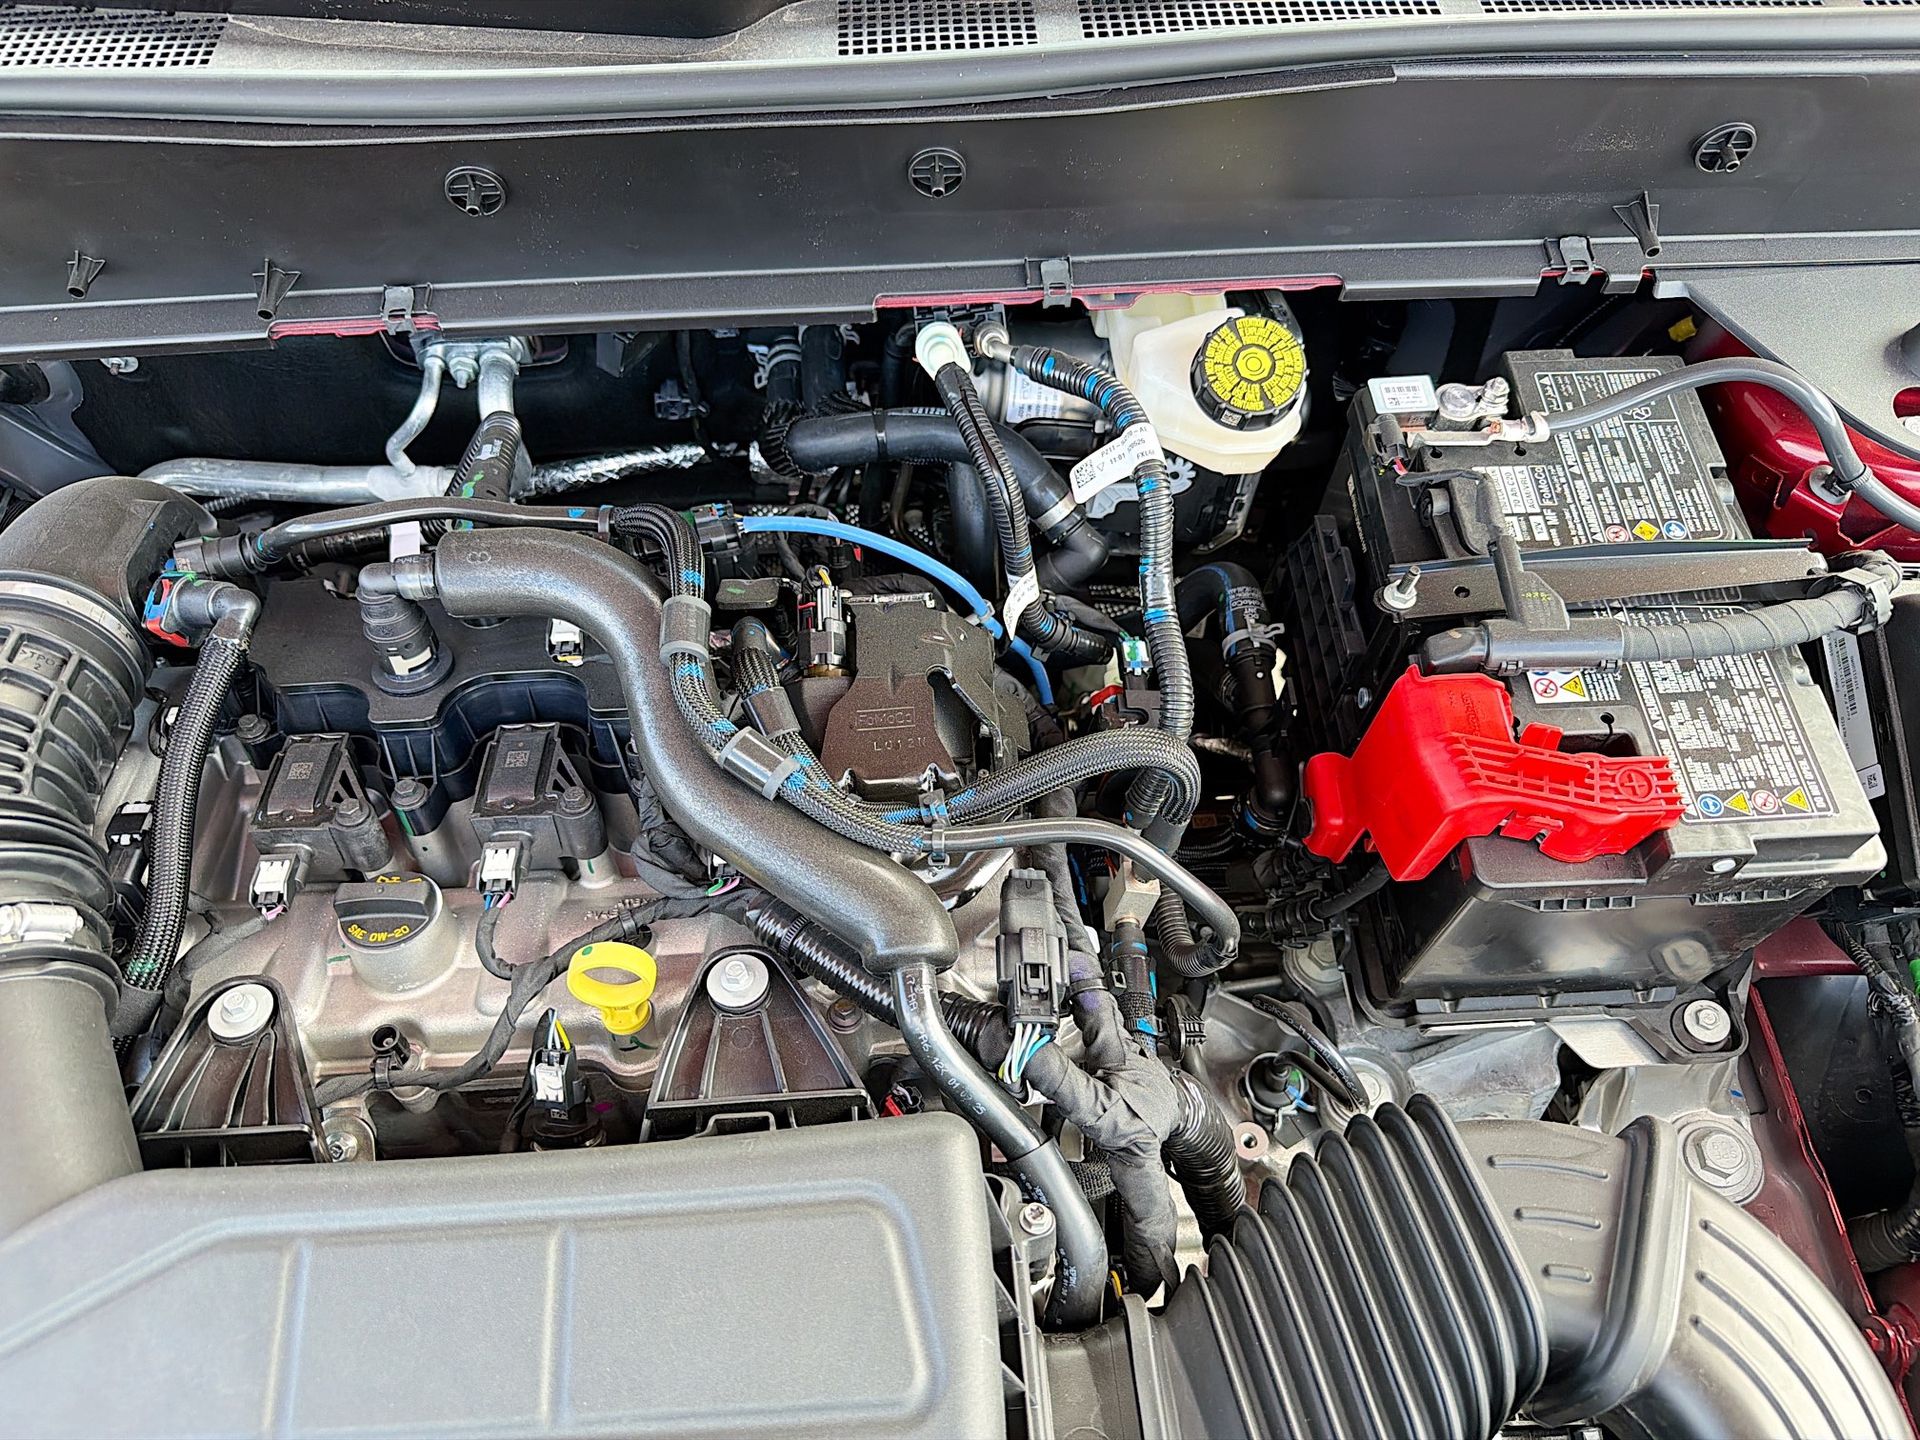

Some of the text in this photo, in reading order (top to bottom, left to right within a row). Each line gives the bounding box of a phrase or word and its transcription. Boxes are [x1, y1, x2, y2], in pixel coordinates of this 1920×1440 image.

[1531, 466, 1554, 504] FoMoCo
[1542, 508, 1560, 525] MF
[859, 711, 912, 726] FoMoCo
[347, 924, 367, 940] SAE
